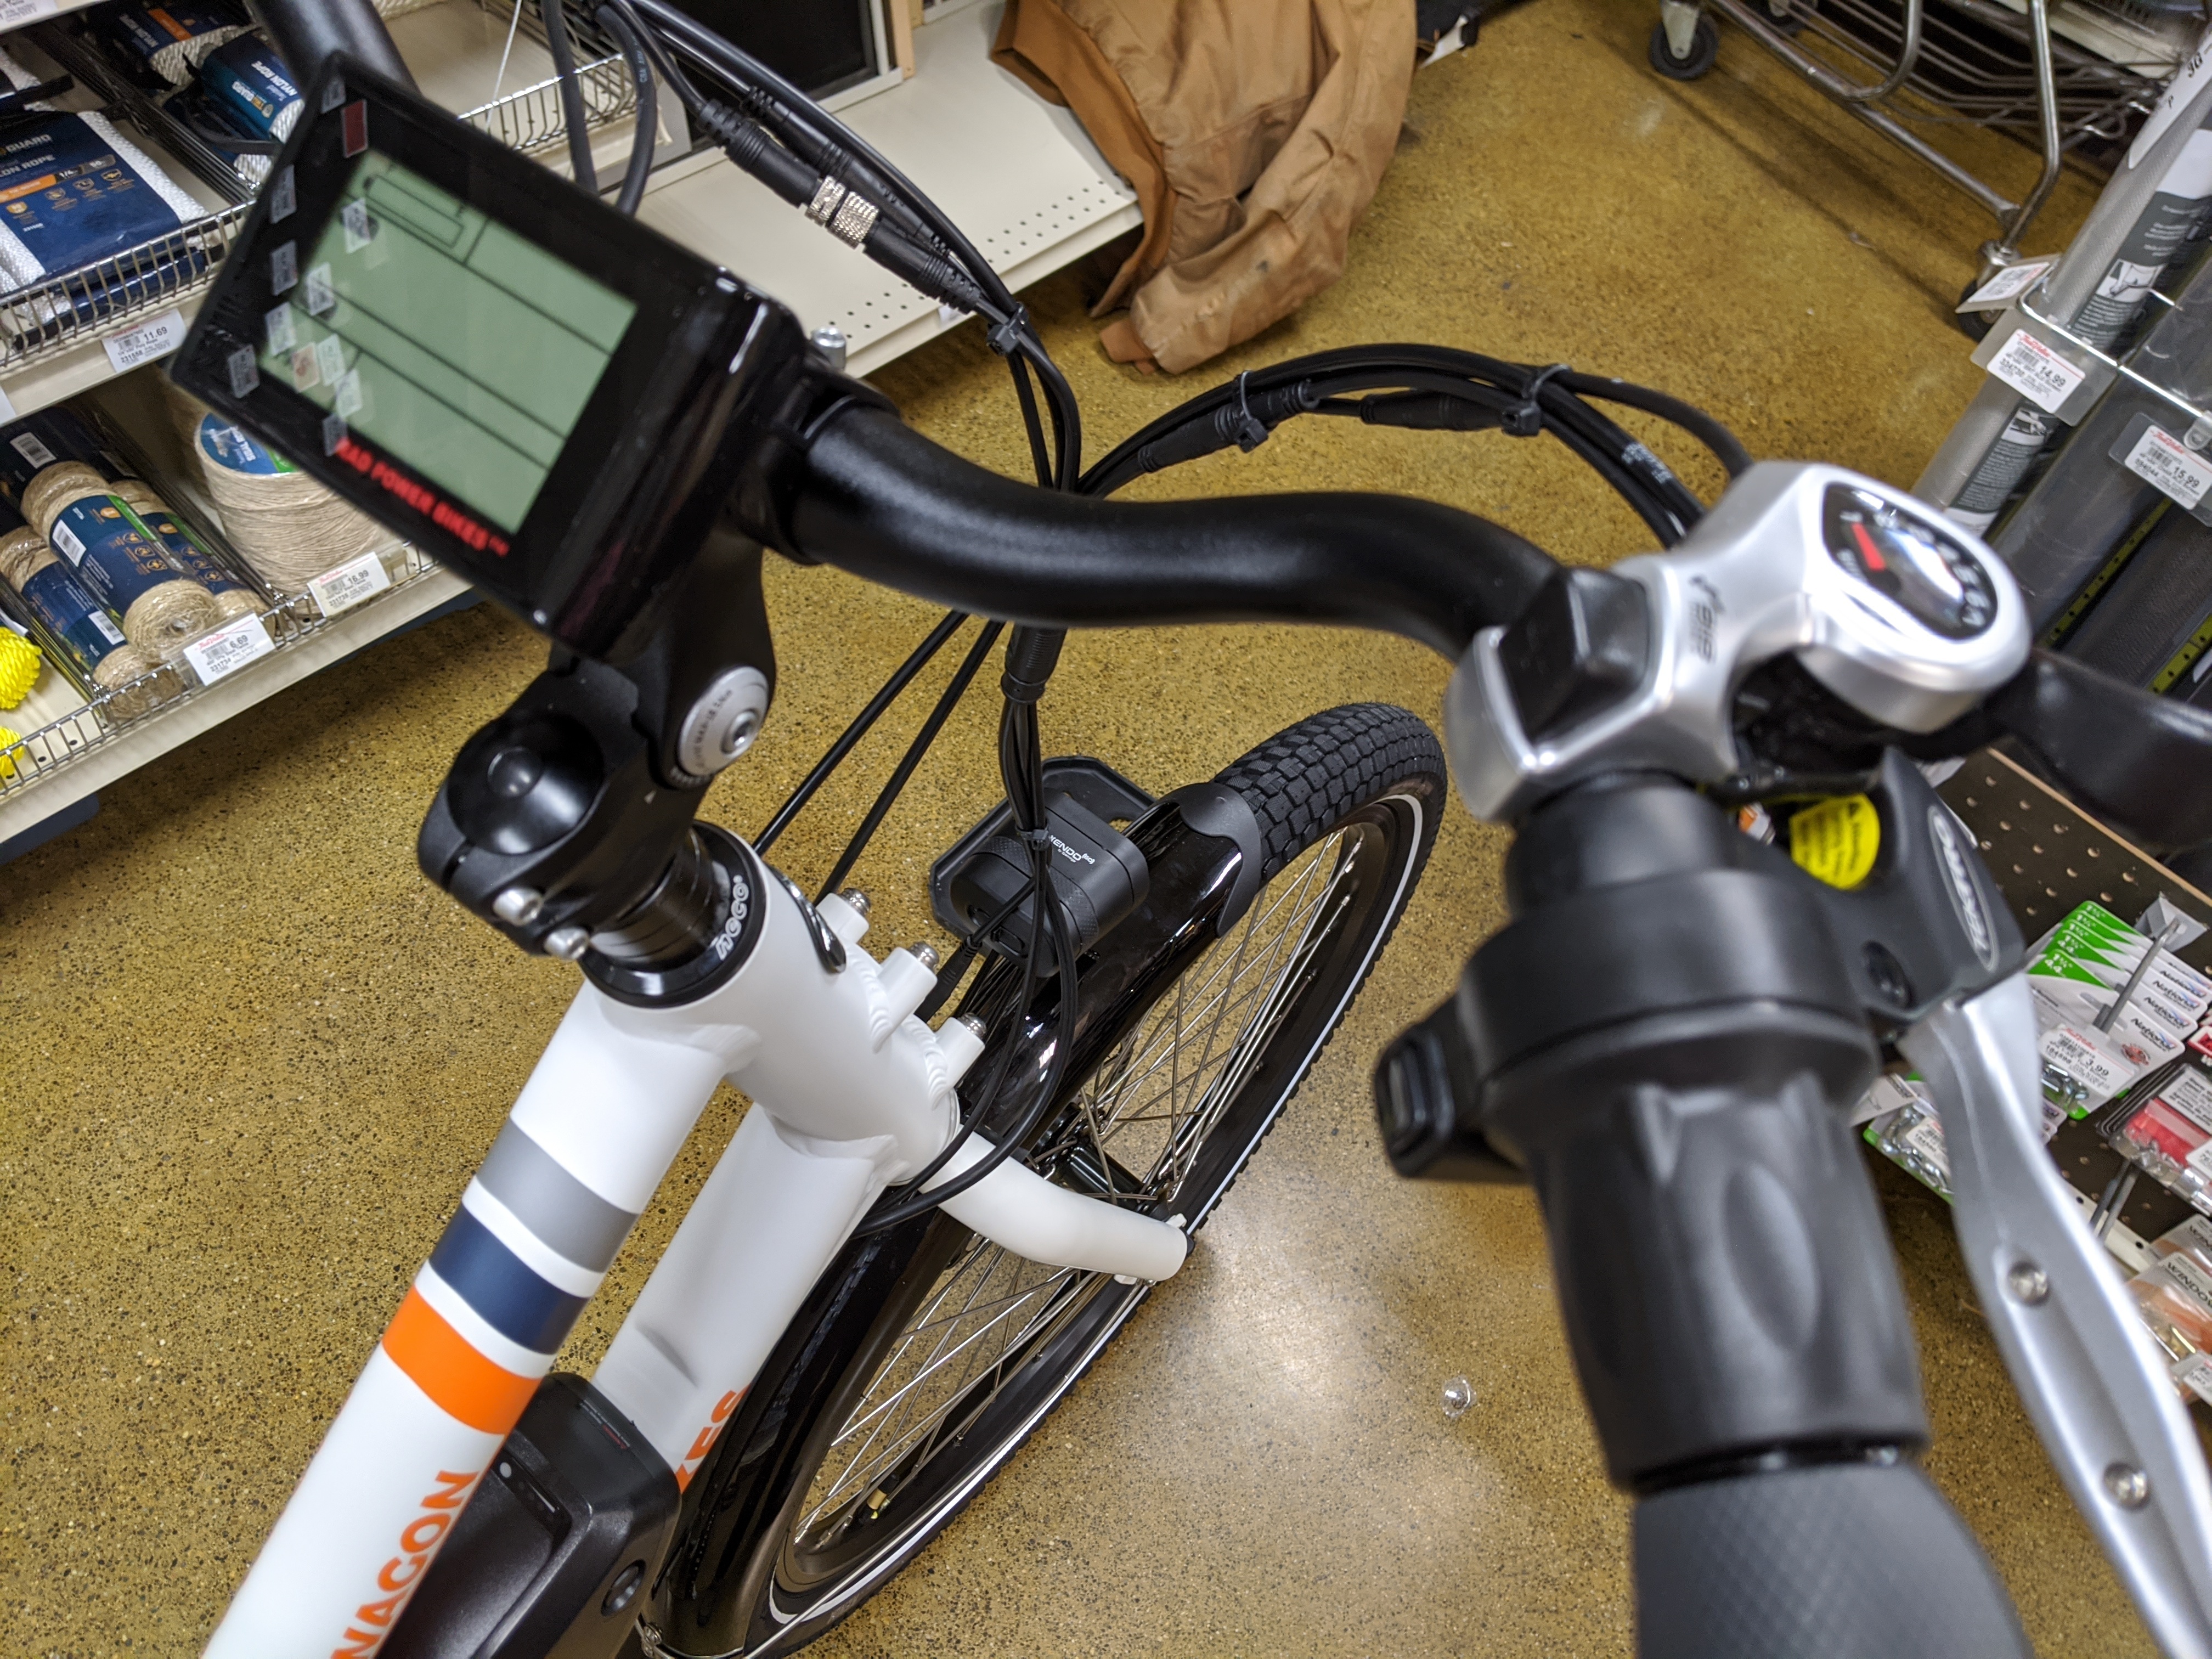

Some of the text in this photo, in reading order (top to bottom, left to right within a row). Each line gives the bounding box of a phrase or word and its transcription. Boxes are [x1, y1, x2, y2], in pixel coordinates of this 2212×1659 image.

[251, 58, 297, 97] NYLON ROPE
[144, 326, 167, 341] 11.69
[2039, 365, 2067, 388] 14.99
[371, 461, 436, 515] POWER
[2172, 466, 2200, 488] 15.99
[347, 569, 369, 584] 16.99
[229, 634, 249, 648] 6.69
[2152, 976, 2199, 1011] National
[2142, 996, 2190, 1030] National
[2129, 1017, 2177, 1052] National
[2085, 1058, 2110, 1077] 3.99
